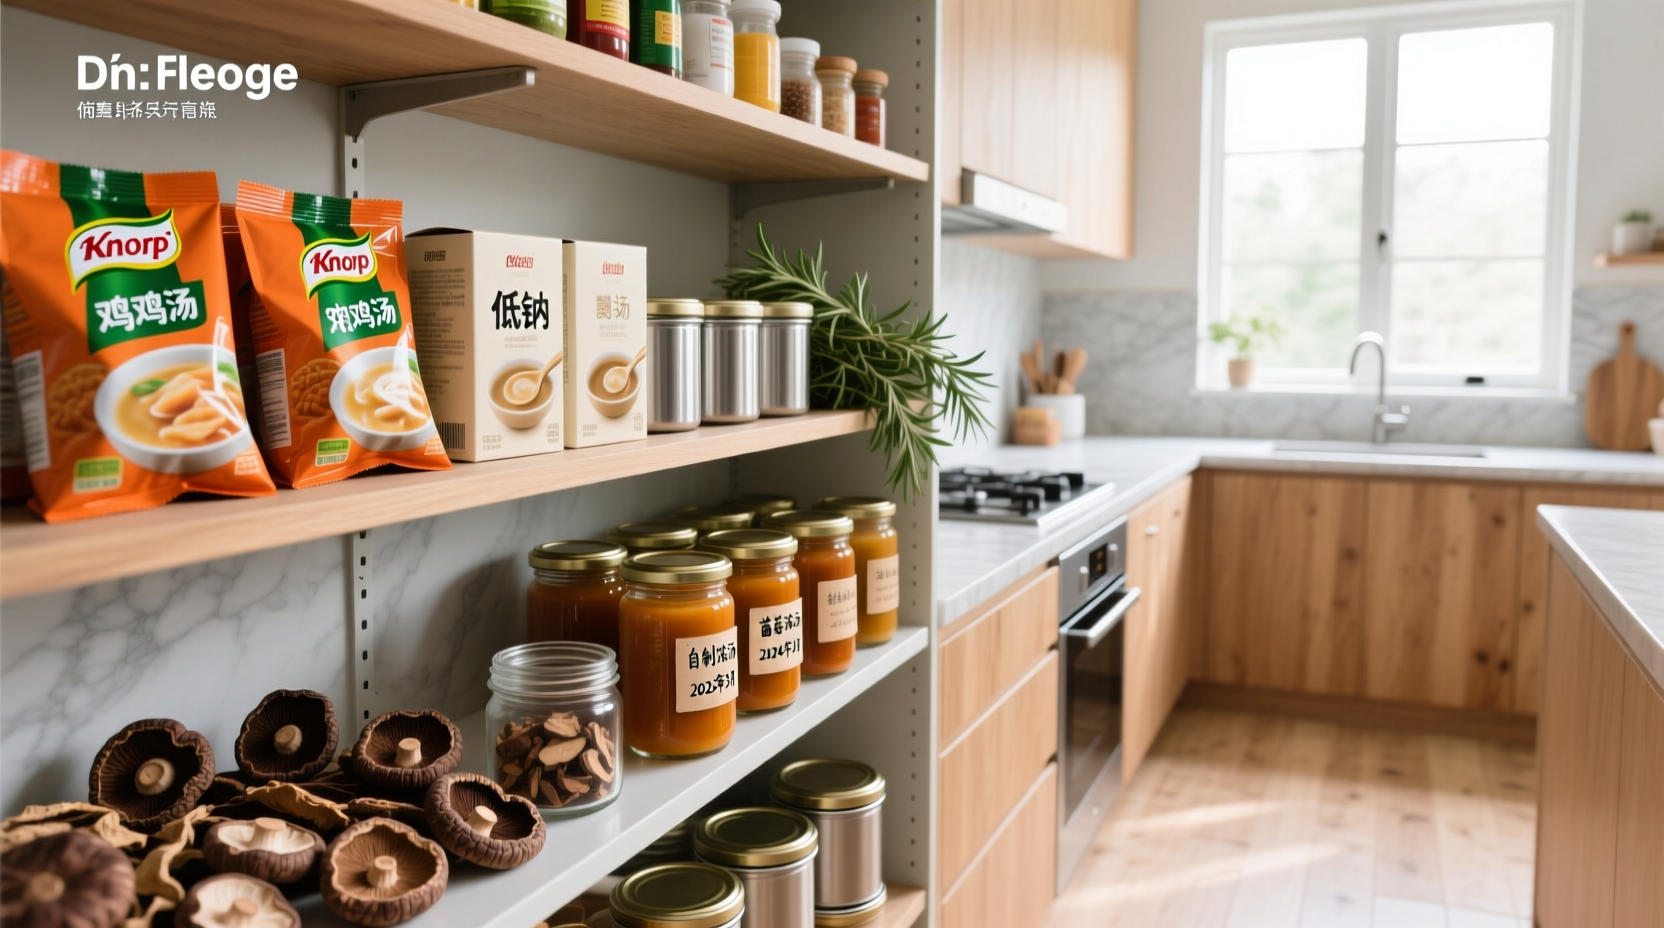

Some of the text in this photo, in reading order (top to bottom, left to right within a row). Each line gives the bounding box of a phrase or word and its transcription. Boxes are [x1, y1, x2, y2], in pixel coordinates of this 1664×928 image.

[80, 231, 169, 261] Knorp
[310, 249, 369, 274] Knorp
[94, 287, 198, 333] 鸡鸡汤
[491, 289, 549, 330] 低钠
